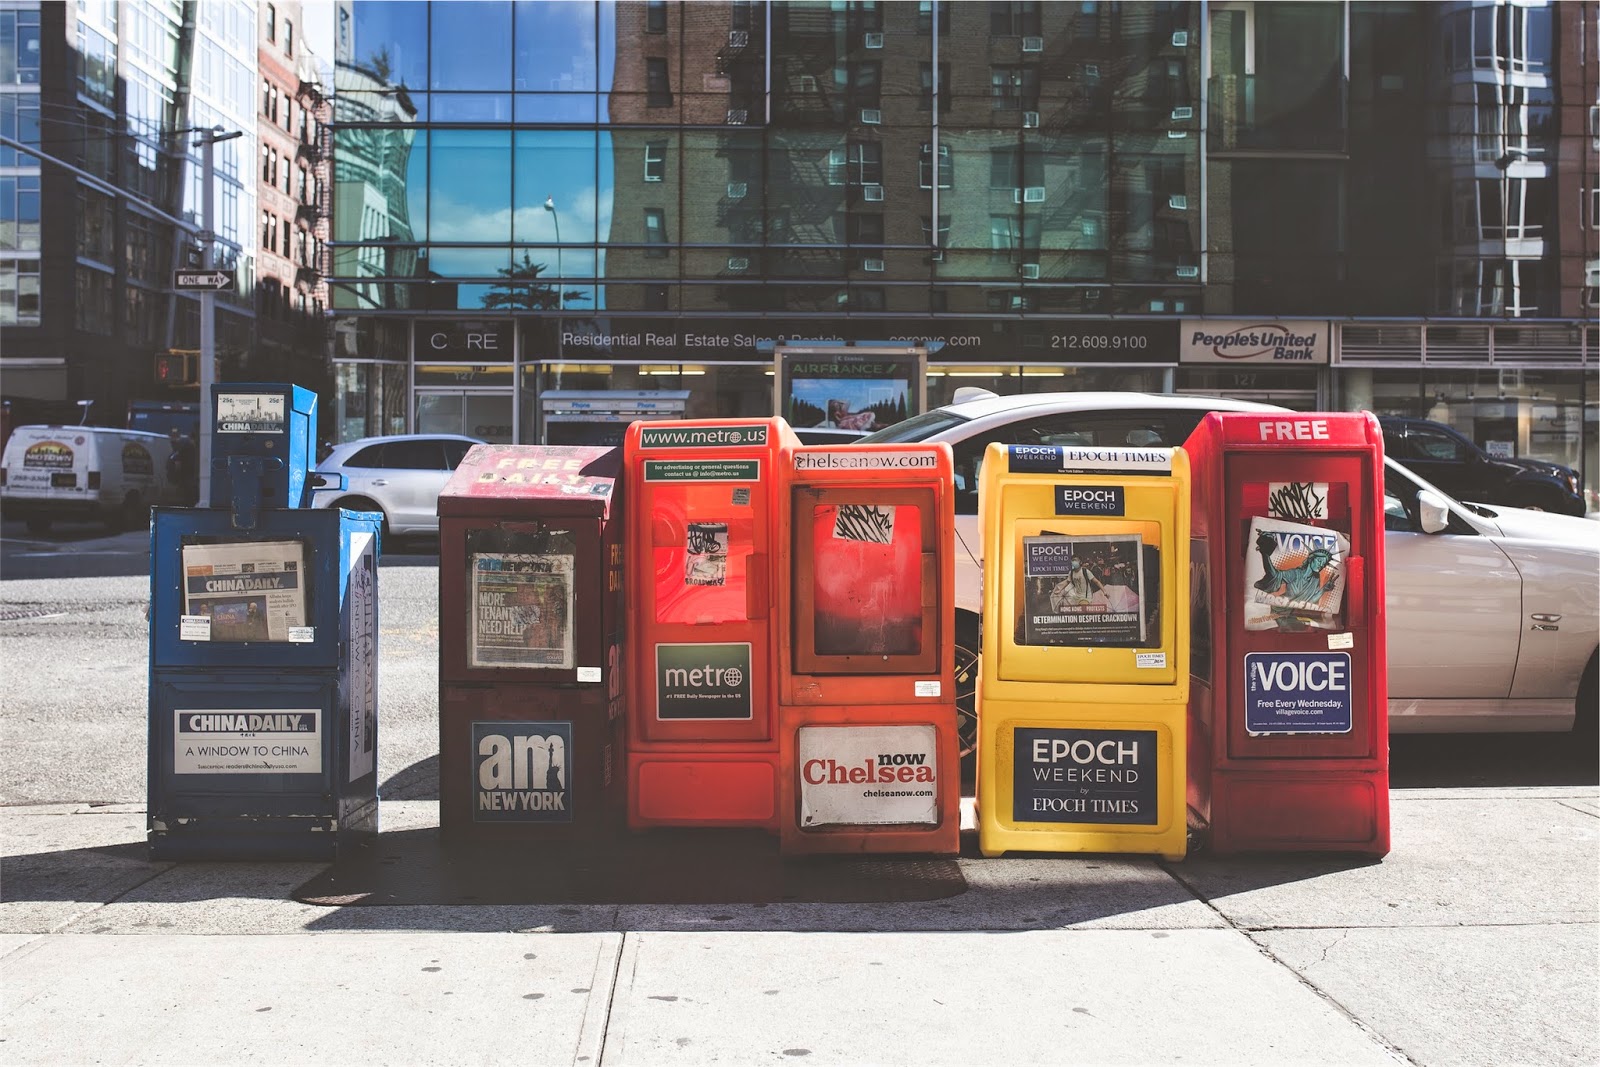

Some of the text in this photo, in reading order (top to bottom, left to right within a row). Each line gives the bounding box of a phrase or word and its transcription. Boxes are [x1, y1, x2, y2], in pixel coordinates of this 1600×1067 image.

[182, 276, 224, 284] ONE WAY
[430, 333, 498, 349] CRE
[562, 332, 641, 346] Residential
[646, 333, 677, 346] Real
[685, 334, 730, 347] Estate
[1052, 336, 1147, 348] 212.609.9100
[1192, 332, 1316, 349] People's United
[1274, 346, 1314, 360] Bank
[1234, 374, 1257, 386] 127
[643, 430, 766, 444] www.metro.us
[1259, 420, 1329, 440] FREE
[1069, 450, 1166, 462] EPOCH TIMES
[497, 458, 583, 470] FREE
[1064, 490, 1115, 501] EPOCH
[1064, 502, 1116, 510] WEEKEND
[1032, 546, 1069, 555] EPOCH
[206, 578, 281, 592] CHINADAILY
[479, 592, 505, 606] MORE
[479, 606, 515, 620] TENANT
[1033, 614, 1138, 624] DETERMINATION DESPITE CRACKDOWN
[479, 620, 527, 635] NEED HELP
[665, 664, 743, 687] metro
[1256, 661, 1346, 691] VOICE
[1257, 699, 1343, 709] Free Every Wednesday.
[189, 714, 302, 732] CHINADAILY
[185, 746, 309, 756] A WINDOW TO CHINA
[1033, 739, 1138, 764] EPOCH
[478, 734, 565, 790] am
[878, 753, 926, 766] now
[803, 759, 936, 784] Chelsea
[1033, 768, 1138, 784] WEEKEND
[863, 790, 933, 798] chelseanow.com
[1080, 787, 1090, 795] by
[479, 792, 565, 810] NEW YORK
[1033, 798, 1139, 814] EPOCH TIMES
